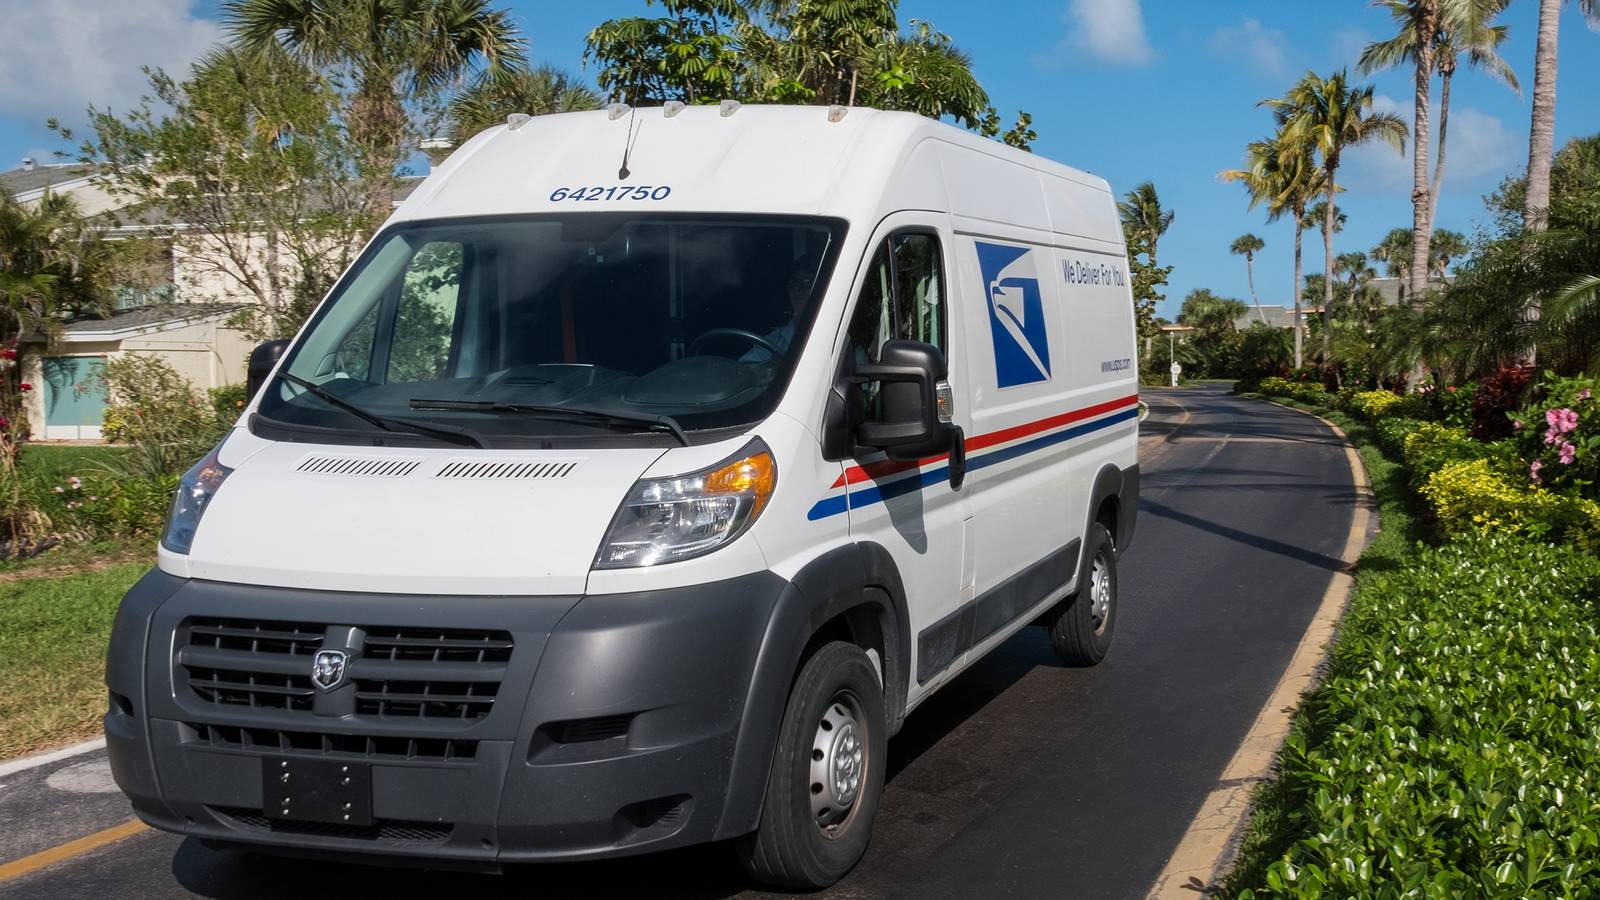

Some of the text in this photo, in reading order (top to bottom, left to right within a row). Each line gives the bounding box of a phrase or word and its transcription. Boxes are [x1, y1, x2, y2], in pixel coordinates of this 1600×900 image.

[549, 185, 672, 202] 6421750
[1061, 258, 1075, 284] We
[1076, 260, 1100, 285] Deliver
[1101, 263, 1111, 287] For
